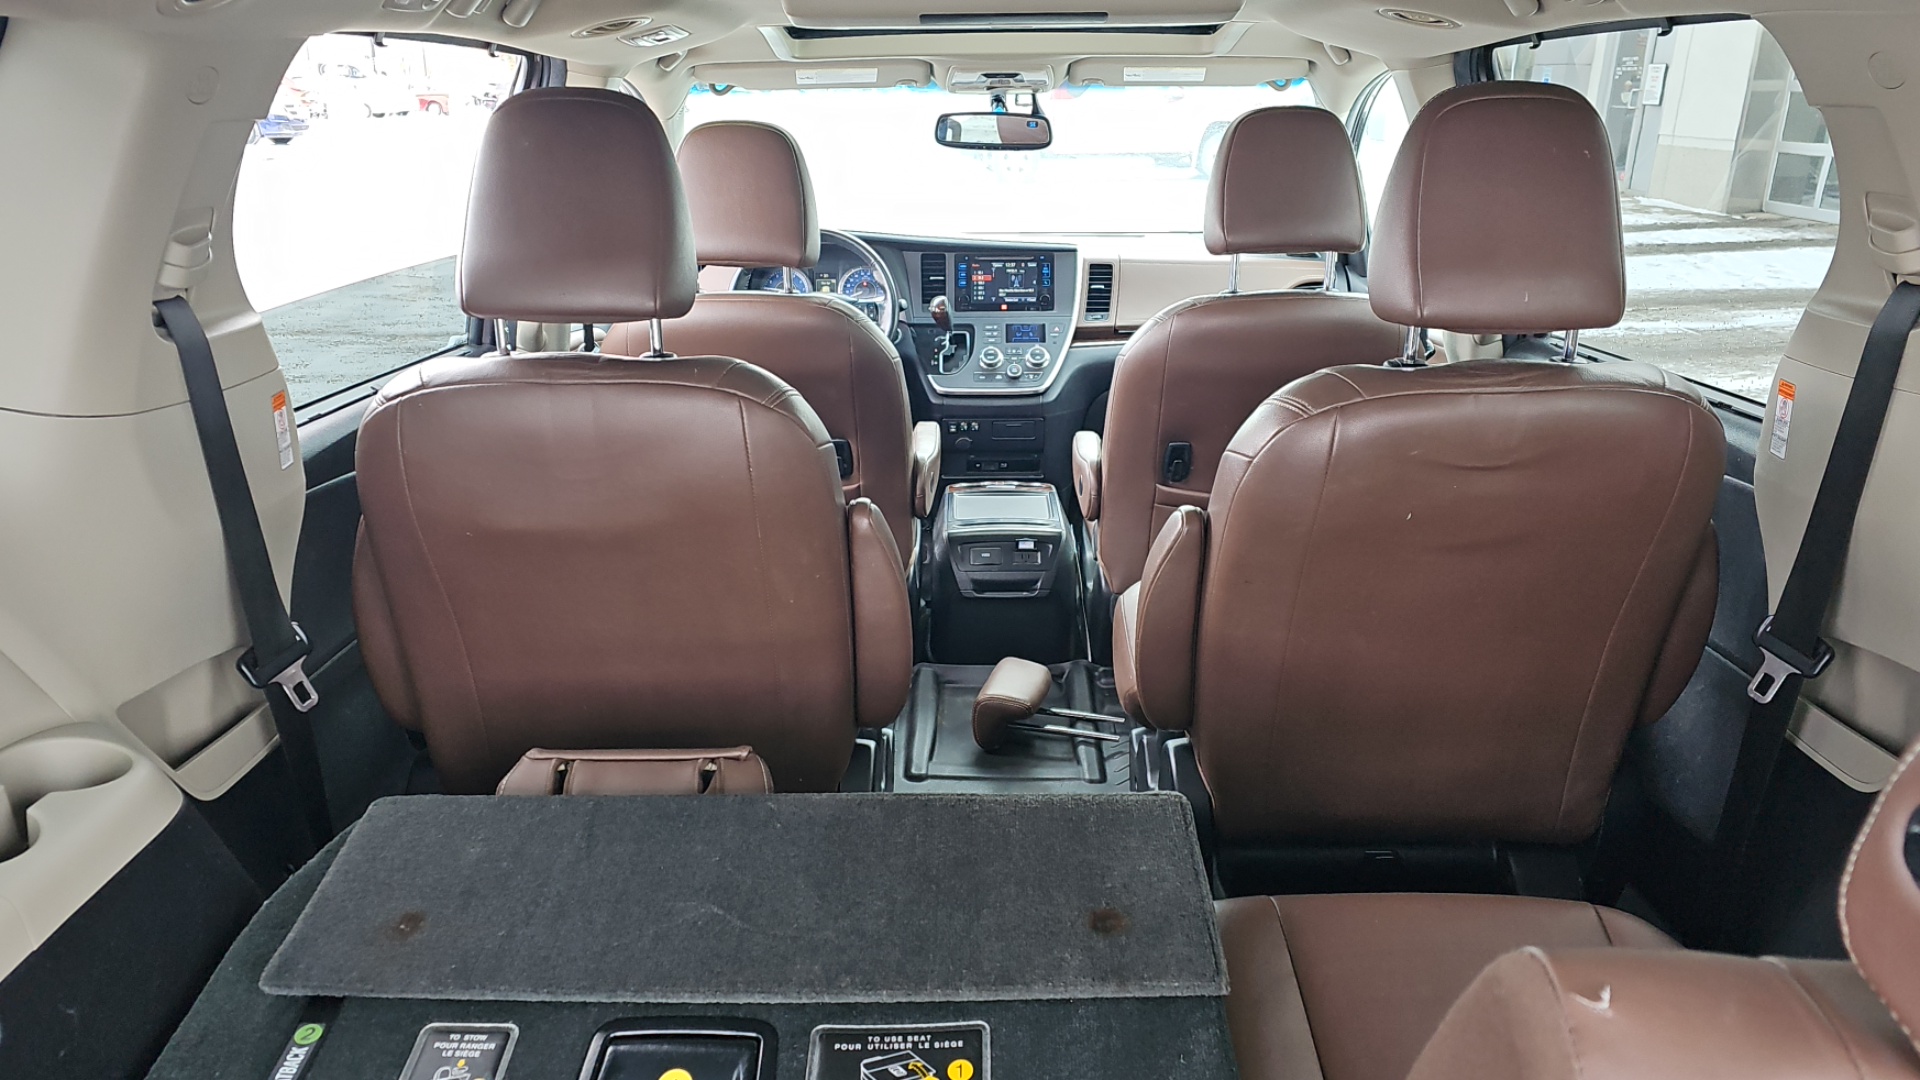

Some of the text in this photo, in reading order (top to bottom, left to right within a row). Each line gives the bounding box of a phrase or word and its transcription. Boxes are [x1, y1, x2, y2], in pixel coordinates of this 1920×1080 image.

[300, 1027, 316, 1041] 2
[449, 1033, 461, 1041] TO
[459, 1042, 497, 1050] RANGER
[441, 1050, 454, 1058] LE
